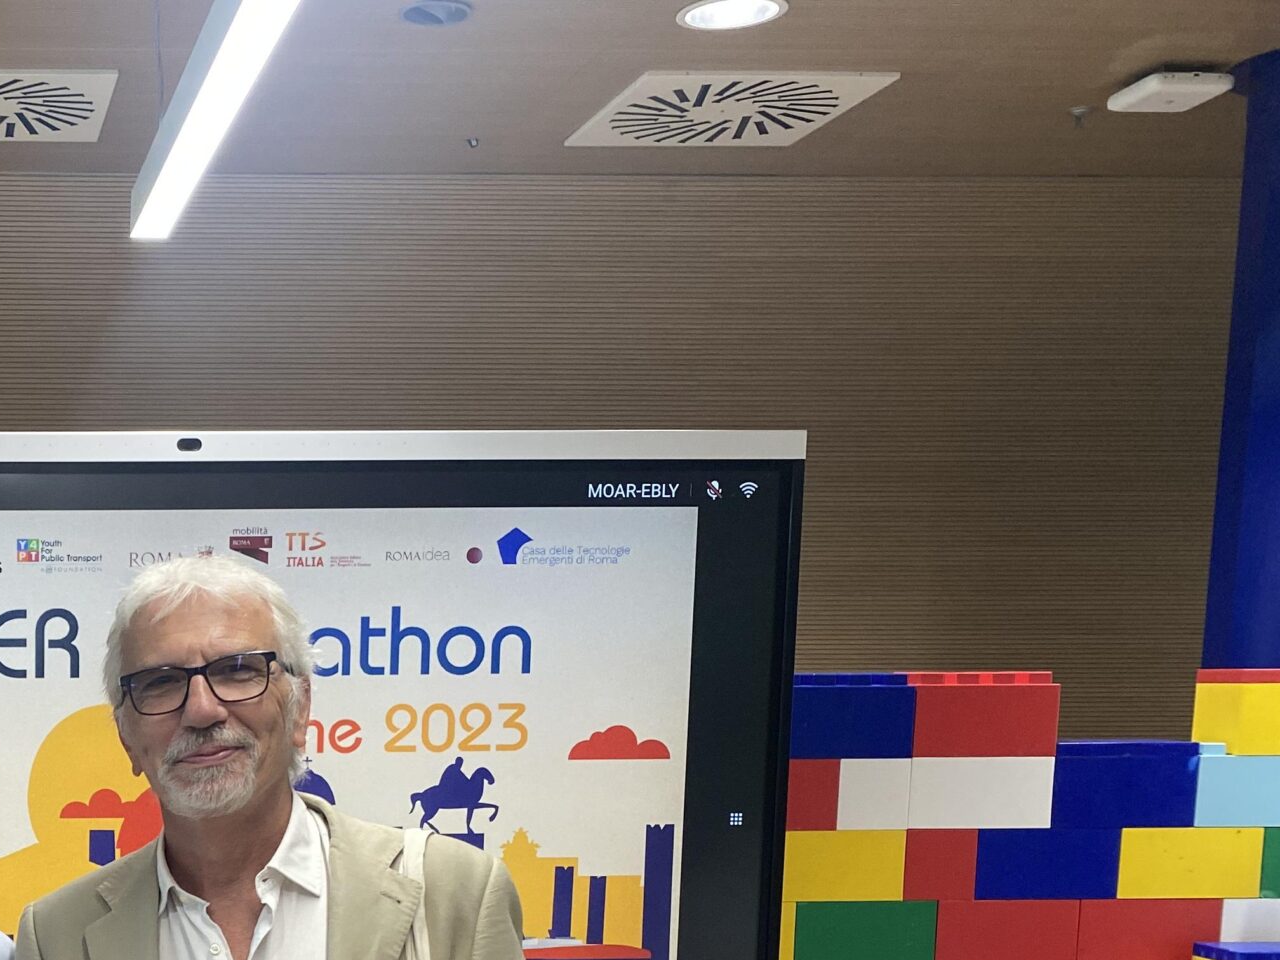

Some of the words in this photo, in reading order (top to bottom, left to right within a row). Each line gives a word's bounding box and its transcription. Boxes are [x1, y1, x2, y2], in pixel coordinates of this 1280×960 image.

[587, 483, 680, 499] MOAR-EBLY
[285, 532, 327, 551] TTS
[521, 546, 546, 555] Casa
[548, 545, 574, 555] delle
[576, 545, 631, 557] Tecnologie
[40, 554, 65, 562] Public
[66, 554, 103, 563] Transport
[129, 551, 183, 568] ROM
[286, 556, 324, 568] ITALIA
[587, 555, 618, 565] Roma
[384, 702, 529, 753] 2023
